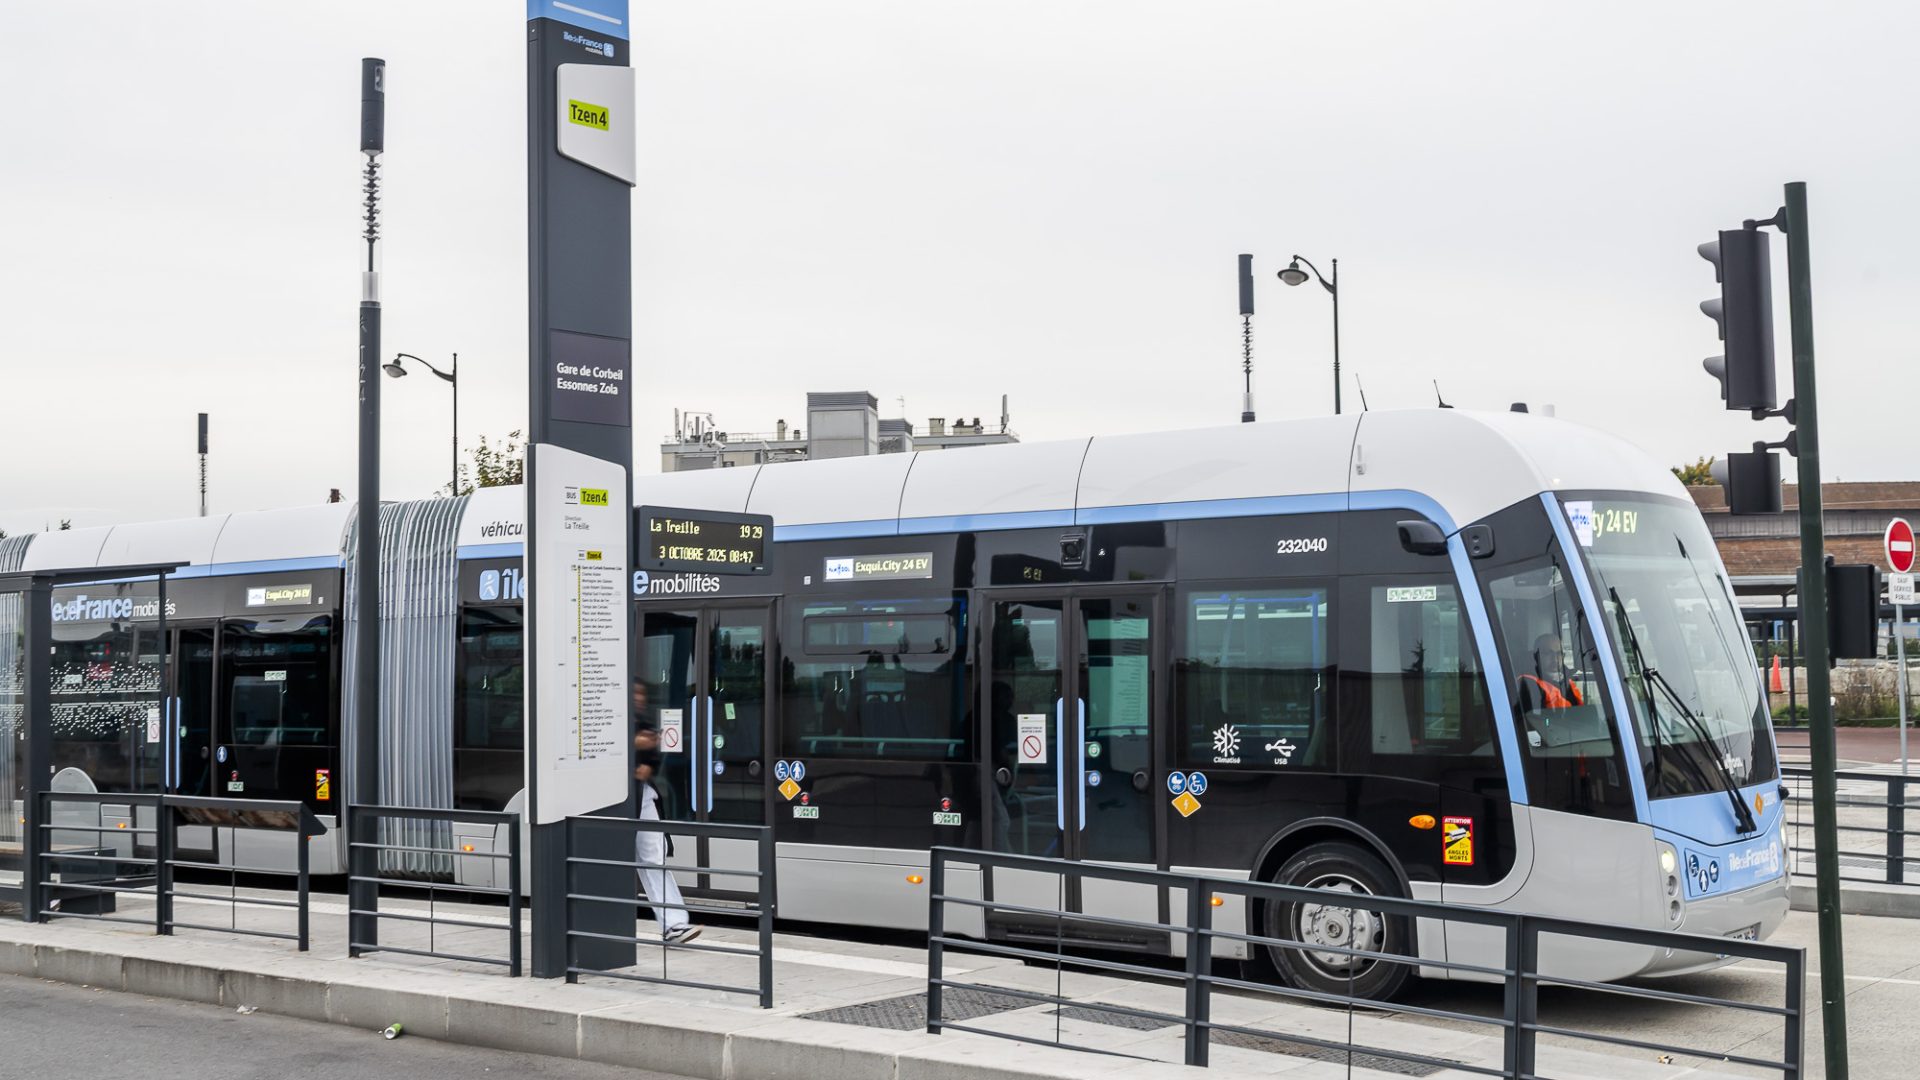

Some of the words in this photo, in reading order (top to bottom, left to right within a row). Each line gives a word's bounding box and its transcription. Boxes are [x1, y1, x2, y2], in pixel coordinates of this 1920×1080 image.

[556, 362, 578, 375] Gare
[579, 365, 591, 377] de
[592, 366, 623, 381] Corbeil
[556, 377, 598, 393] Essonnes
[599, 382, 618, 395] Zola
[566, 491, 577, 499] BUS
[564, 522, 572, 530] La
[573, 522, 590, 530] Treille
[650, 518, 662, 532] La
[665, 519, 700, 535] Treille
[739, 525, 751, 538] 19
[752, 526, 763, 539] 29
[1606, 509, 1621, 532] 24
[1623, 510, 1638, 533] EV
[1277, 537, 1327, 554] 232040
[659, 546, 666, 559] 3
[668, 546, 704, 561] OCTOBRE
[706, 549, 727, 562] 2025
[729, 550, 754, 564] 08:47
[855, 559, 901, 574] Exqui.City
[902, 559, 914, 570] 24
[916, 558, 929, 569] EV
[650, 573, 720, 594] mobilités
